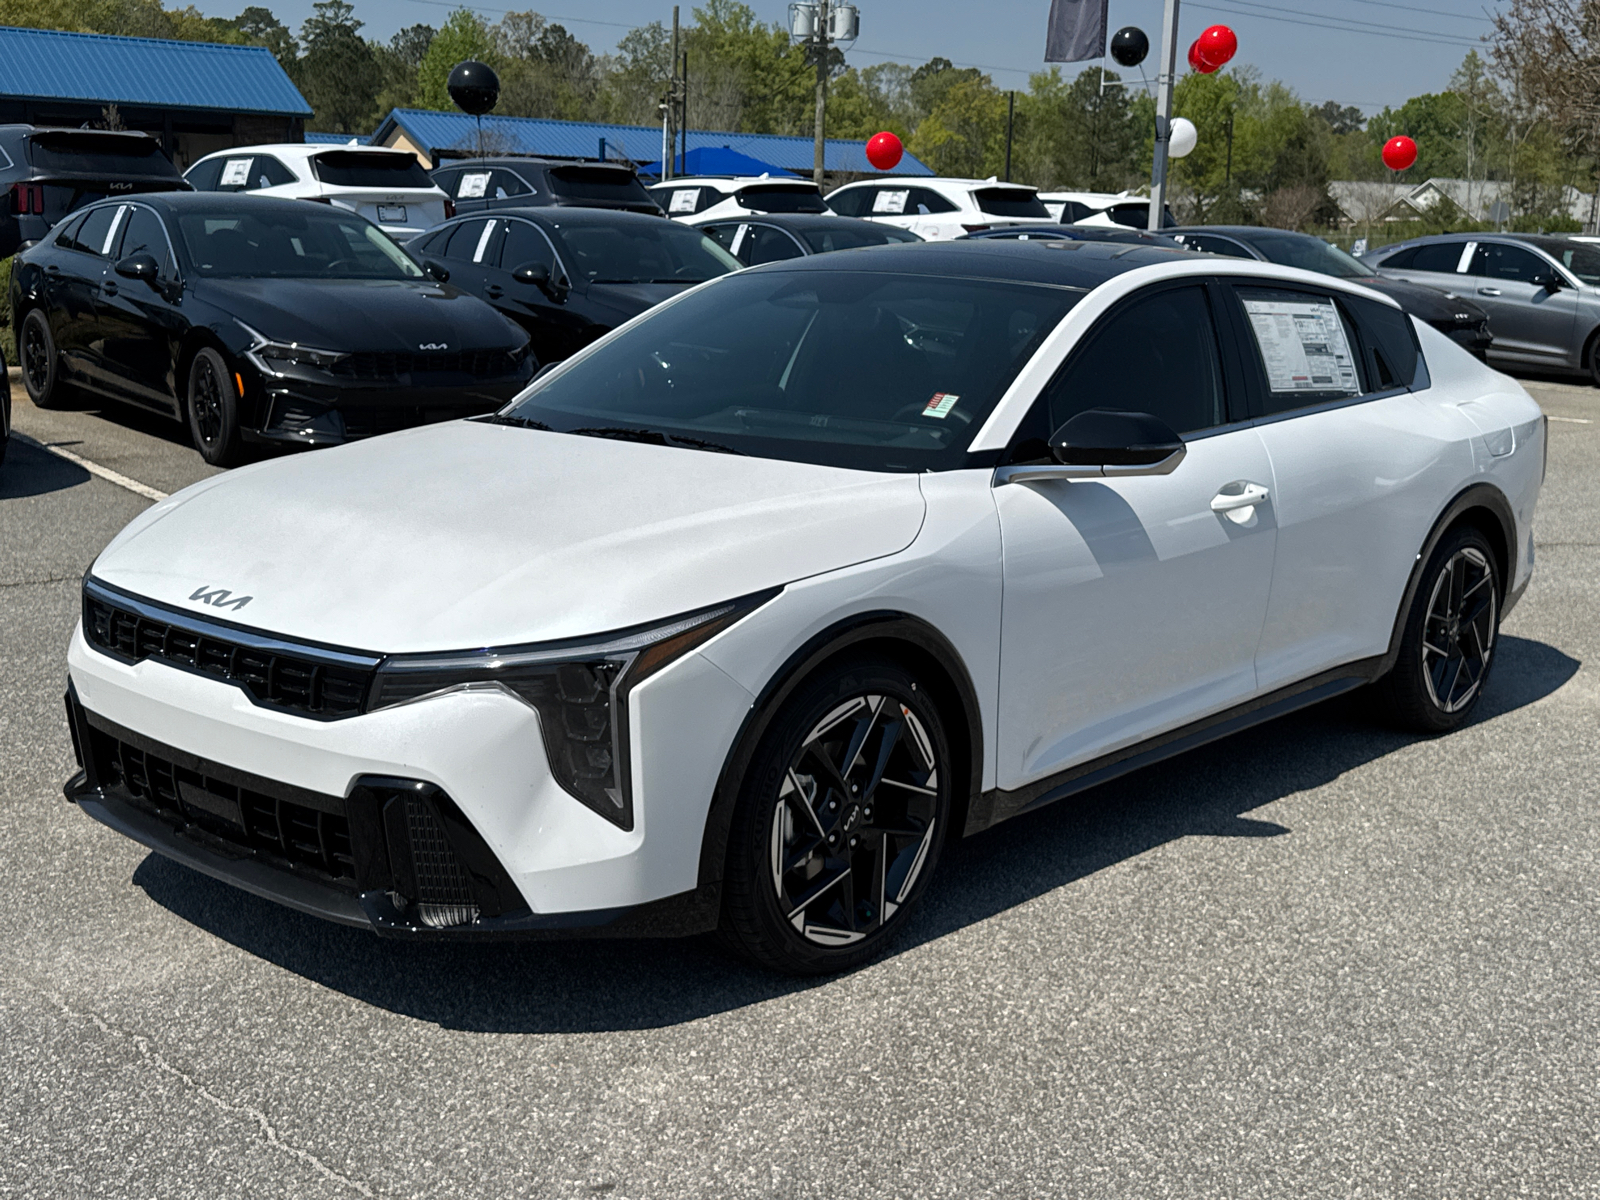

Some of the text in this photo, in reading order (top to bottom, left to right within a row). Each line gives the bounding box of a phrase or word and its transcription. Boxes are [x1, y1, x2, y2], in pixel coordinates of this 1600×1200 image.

[189, 584, 254, 611] KIA
[754, 766, 778, 849] KUMHO
[843, 804, 860, 831] KIA
